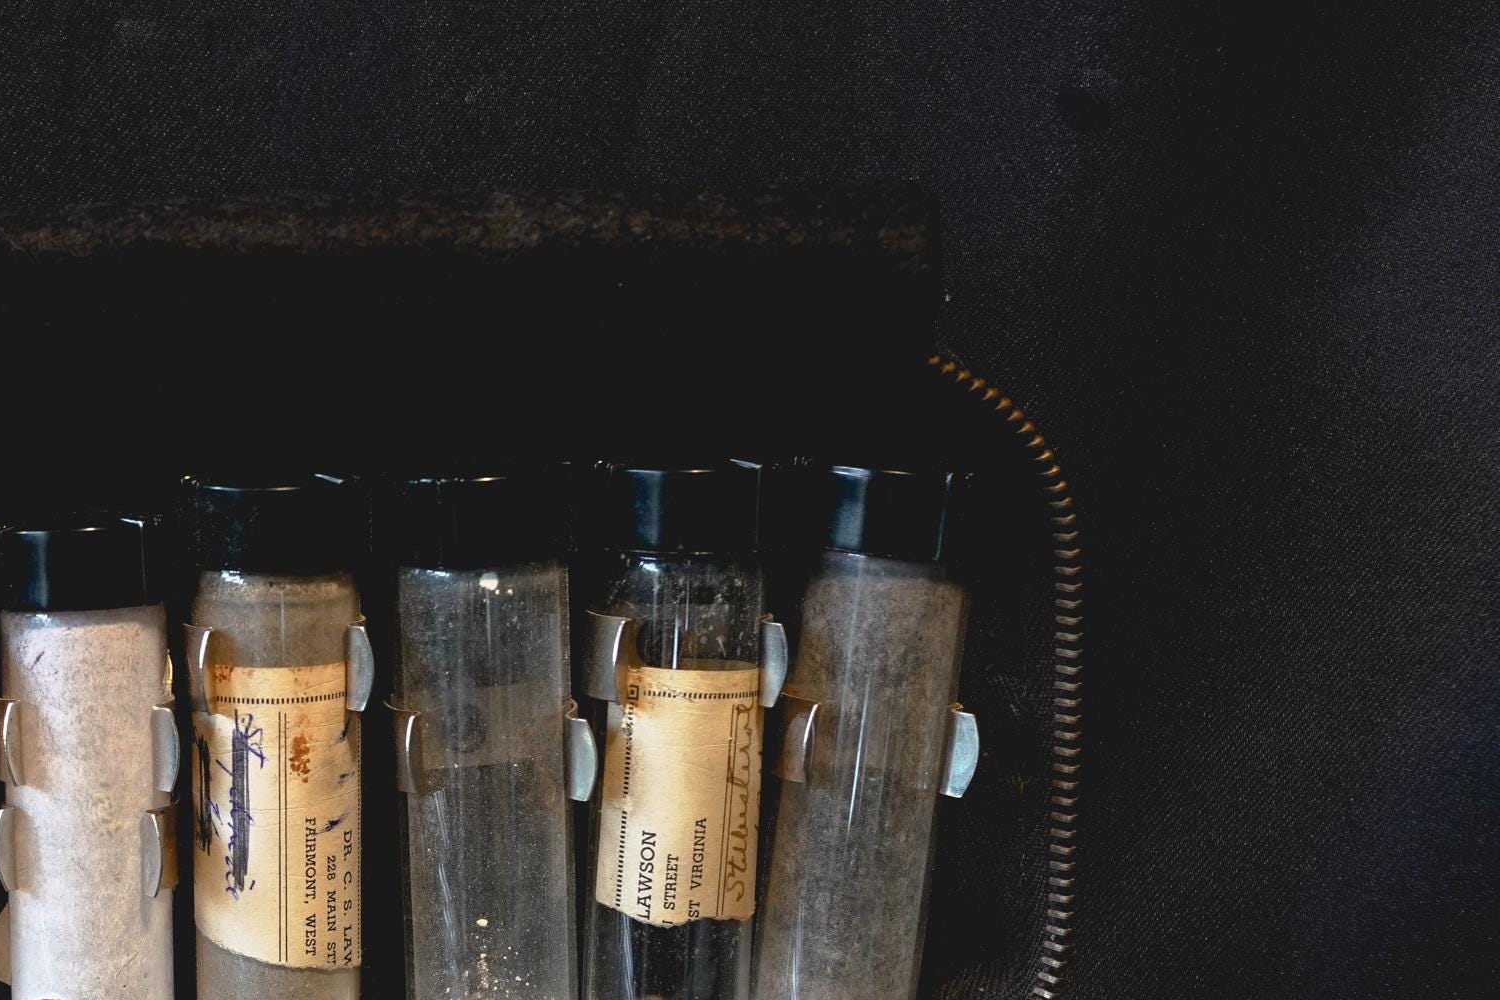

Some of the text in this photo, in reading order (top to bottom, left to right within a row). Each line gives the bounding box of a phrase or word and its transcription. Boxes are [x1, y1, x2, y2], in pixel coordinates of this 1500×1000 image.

[343, 830, 353, 861] DR.
[690, 817, 707, 890] VIRGINIA
[304, 817, 317, 957] FAIRMONT, WEST
[326, 855, 337, 881] 228
[343, 871, 353, 890] C.
[636, 830, 657, 920] LAWSON
[663, 853, 679, 911] STREET
[326, 890, 337, 932] MAIN
[343, 899, 353, 916] S.
